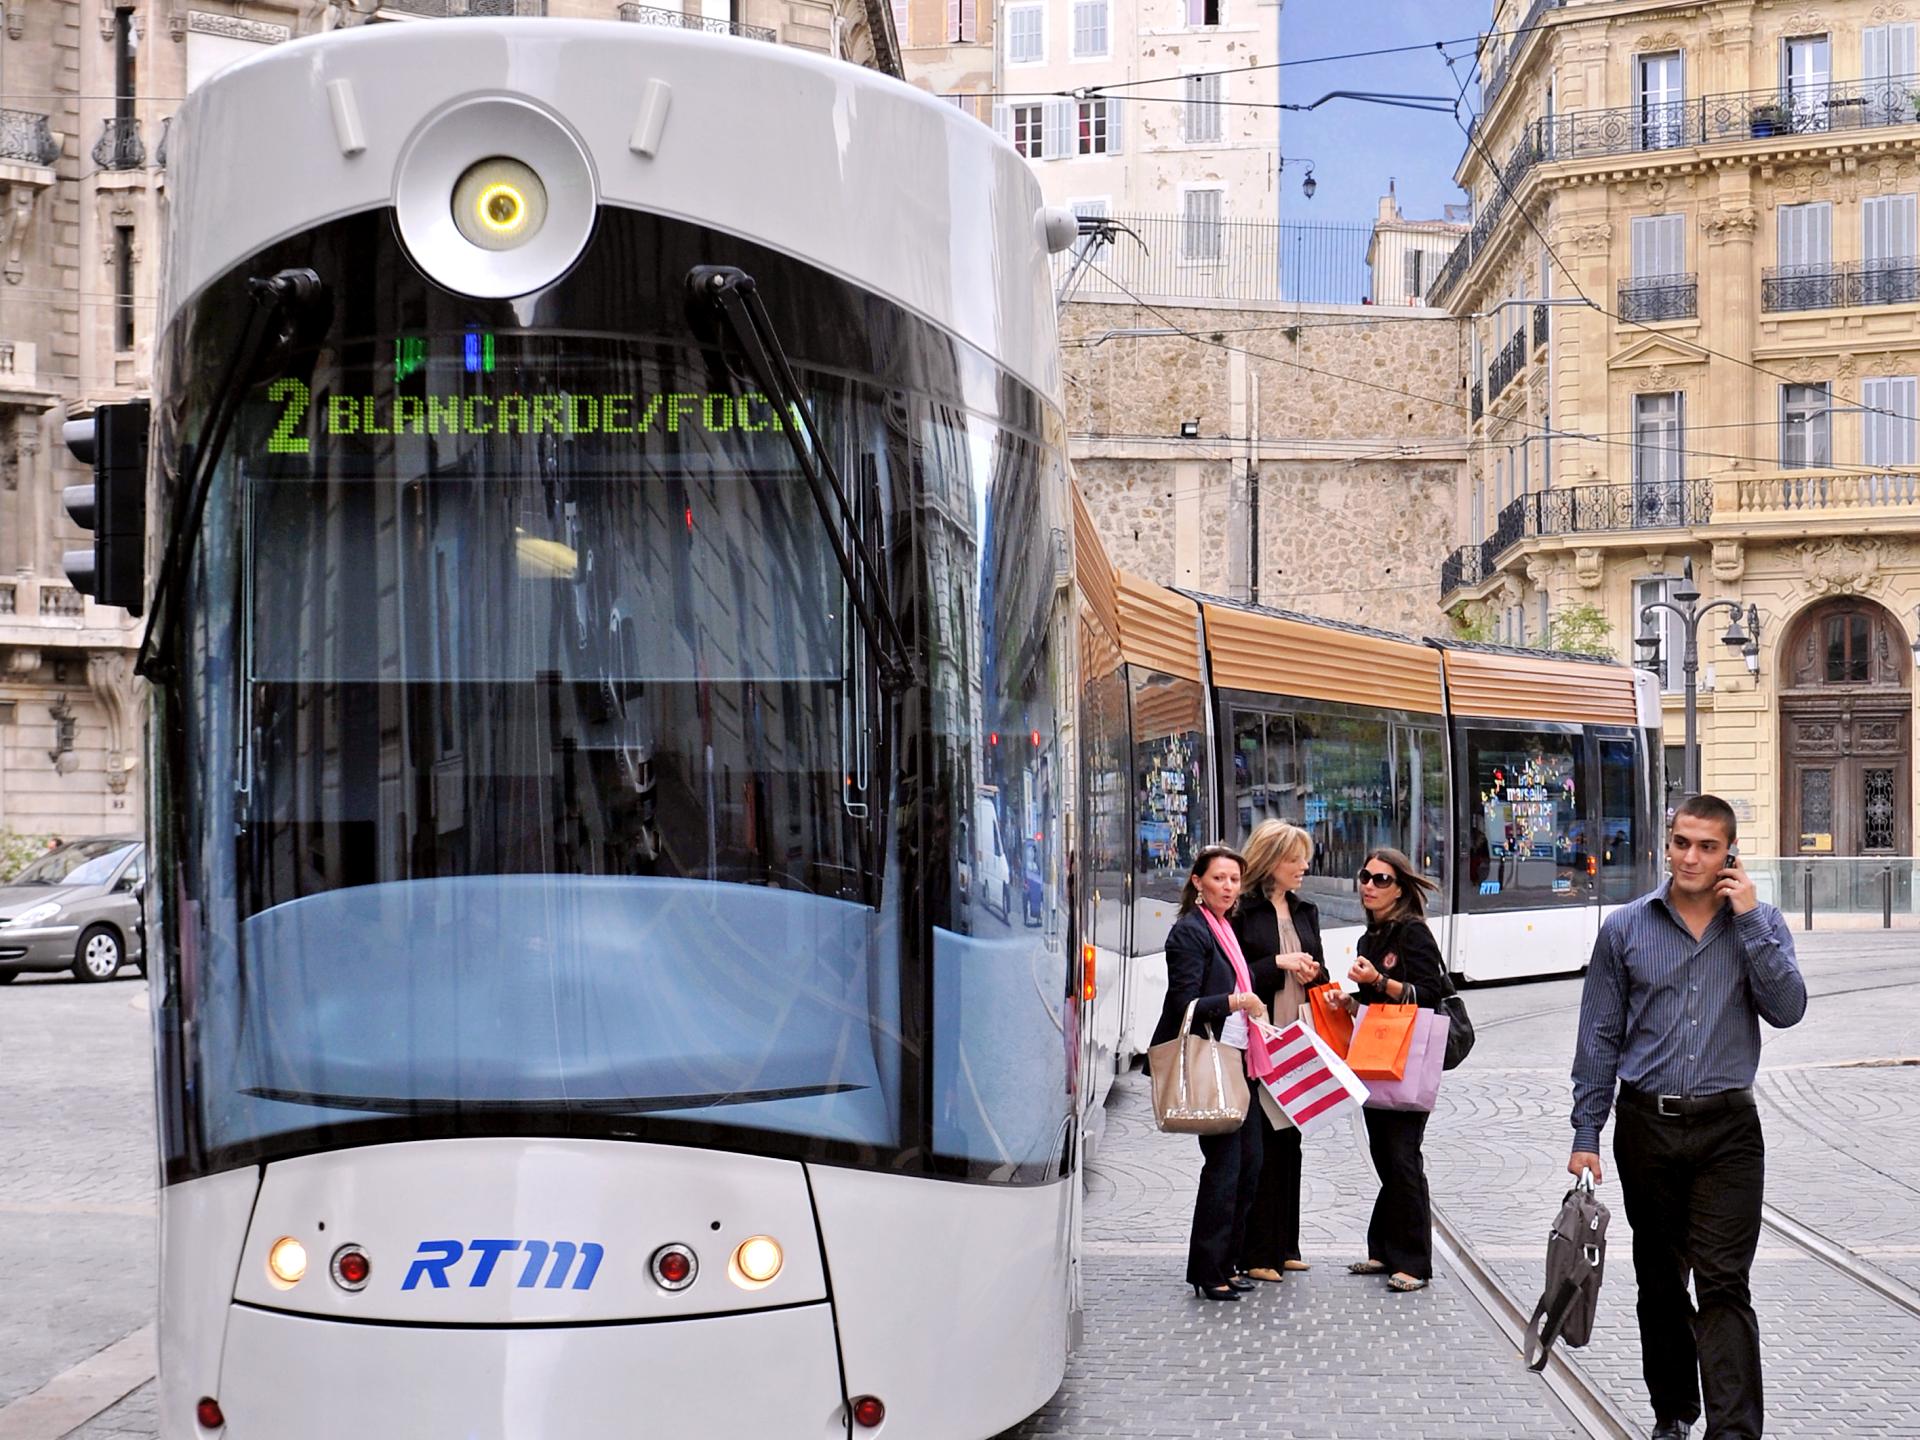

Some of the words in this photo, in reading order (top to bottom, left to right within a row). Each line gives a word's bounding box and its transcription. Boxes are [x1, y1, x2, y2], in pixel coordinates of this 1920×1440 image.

[267, 377, 310, 454] 2
[1479, 881, 1501, 895] RTM
[400, 1239, 605, 1291] RTM
